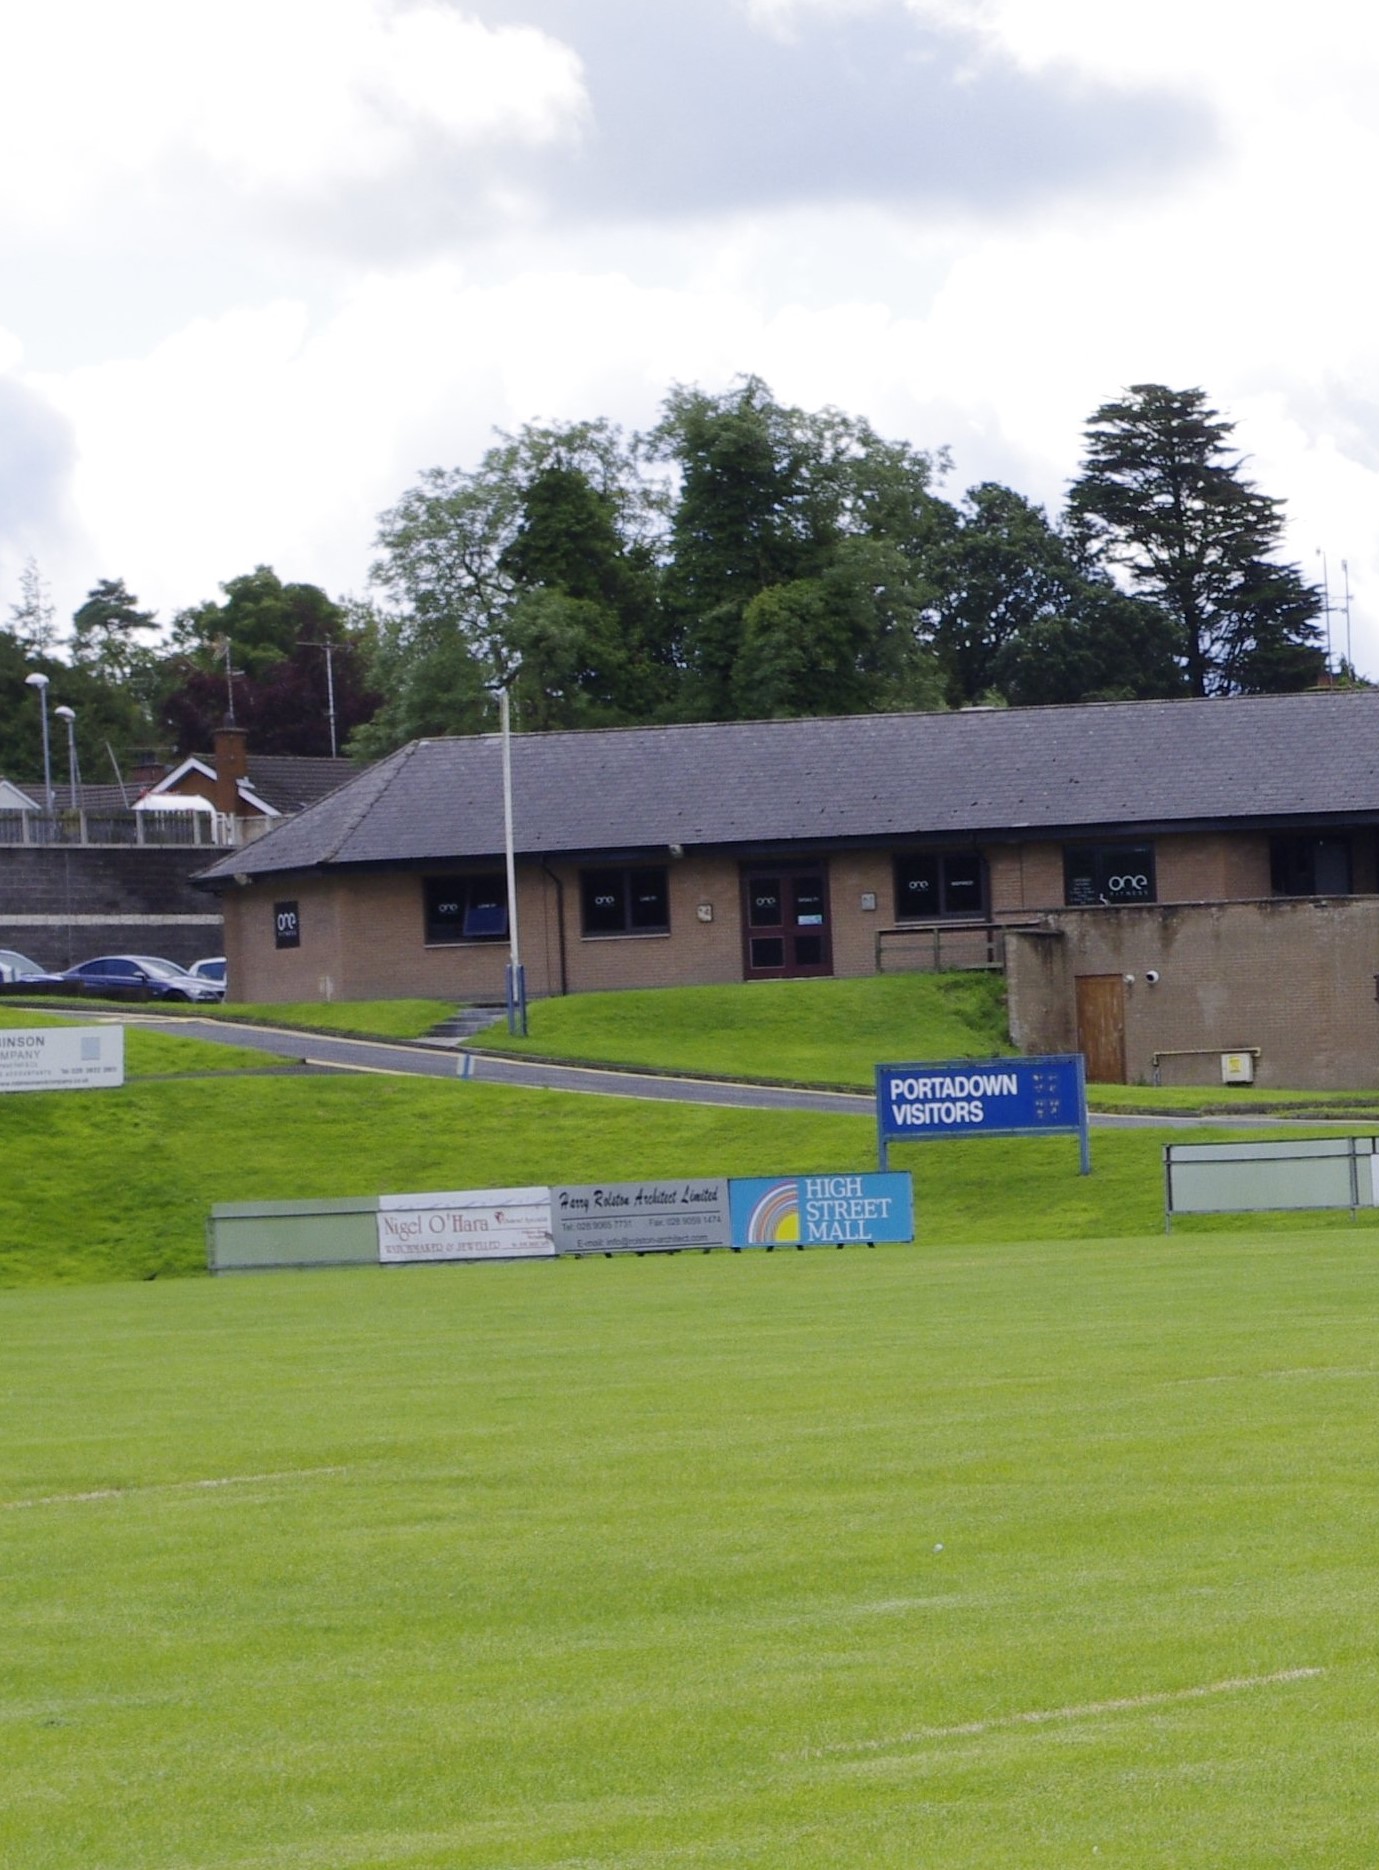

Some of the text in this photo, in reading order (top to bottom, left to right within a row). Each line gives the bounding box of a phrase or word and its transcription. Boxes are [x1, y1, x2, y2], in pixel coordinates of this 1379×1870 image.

[1108, 874, 1148, 891] one
[277, 912, 297, 931] one
[0, 1036, 45, 1048] INSON
[0, 1050, 41, 1061] MPANY
[890, 1074, 1018, 1100] PORTADOWN
[892, 1101, 984, 1125] VISITORS
[559, 1185, 719, 1213] Harry Rolston Architect Limited
[805, 1177, 863, 1199] HIGH
[703, 1214, 722, 1224] 1474
[806, 1198, 892, 1221] STREET
[384, 1213, 489, 1241] Nigel O'Hara
[576, 1222, 592, 1231] 028
[807, 1220, 872, 1242] MALL
